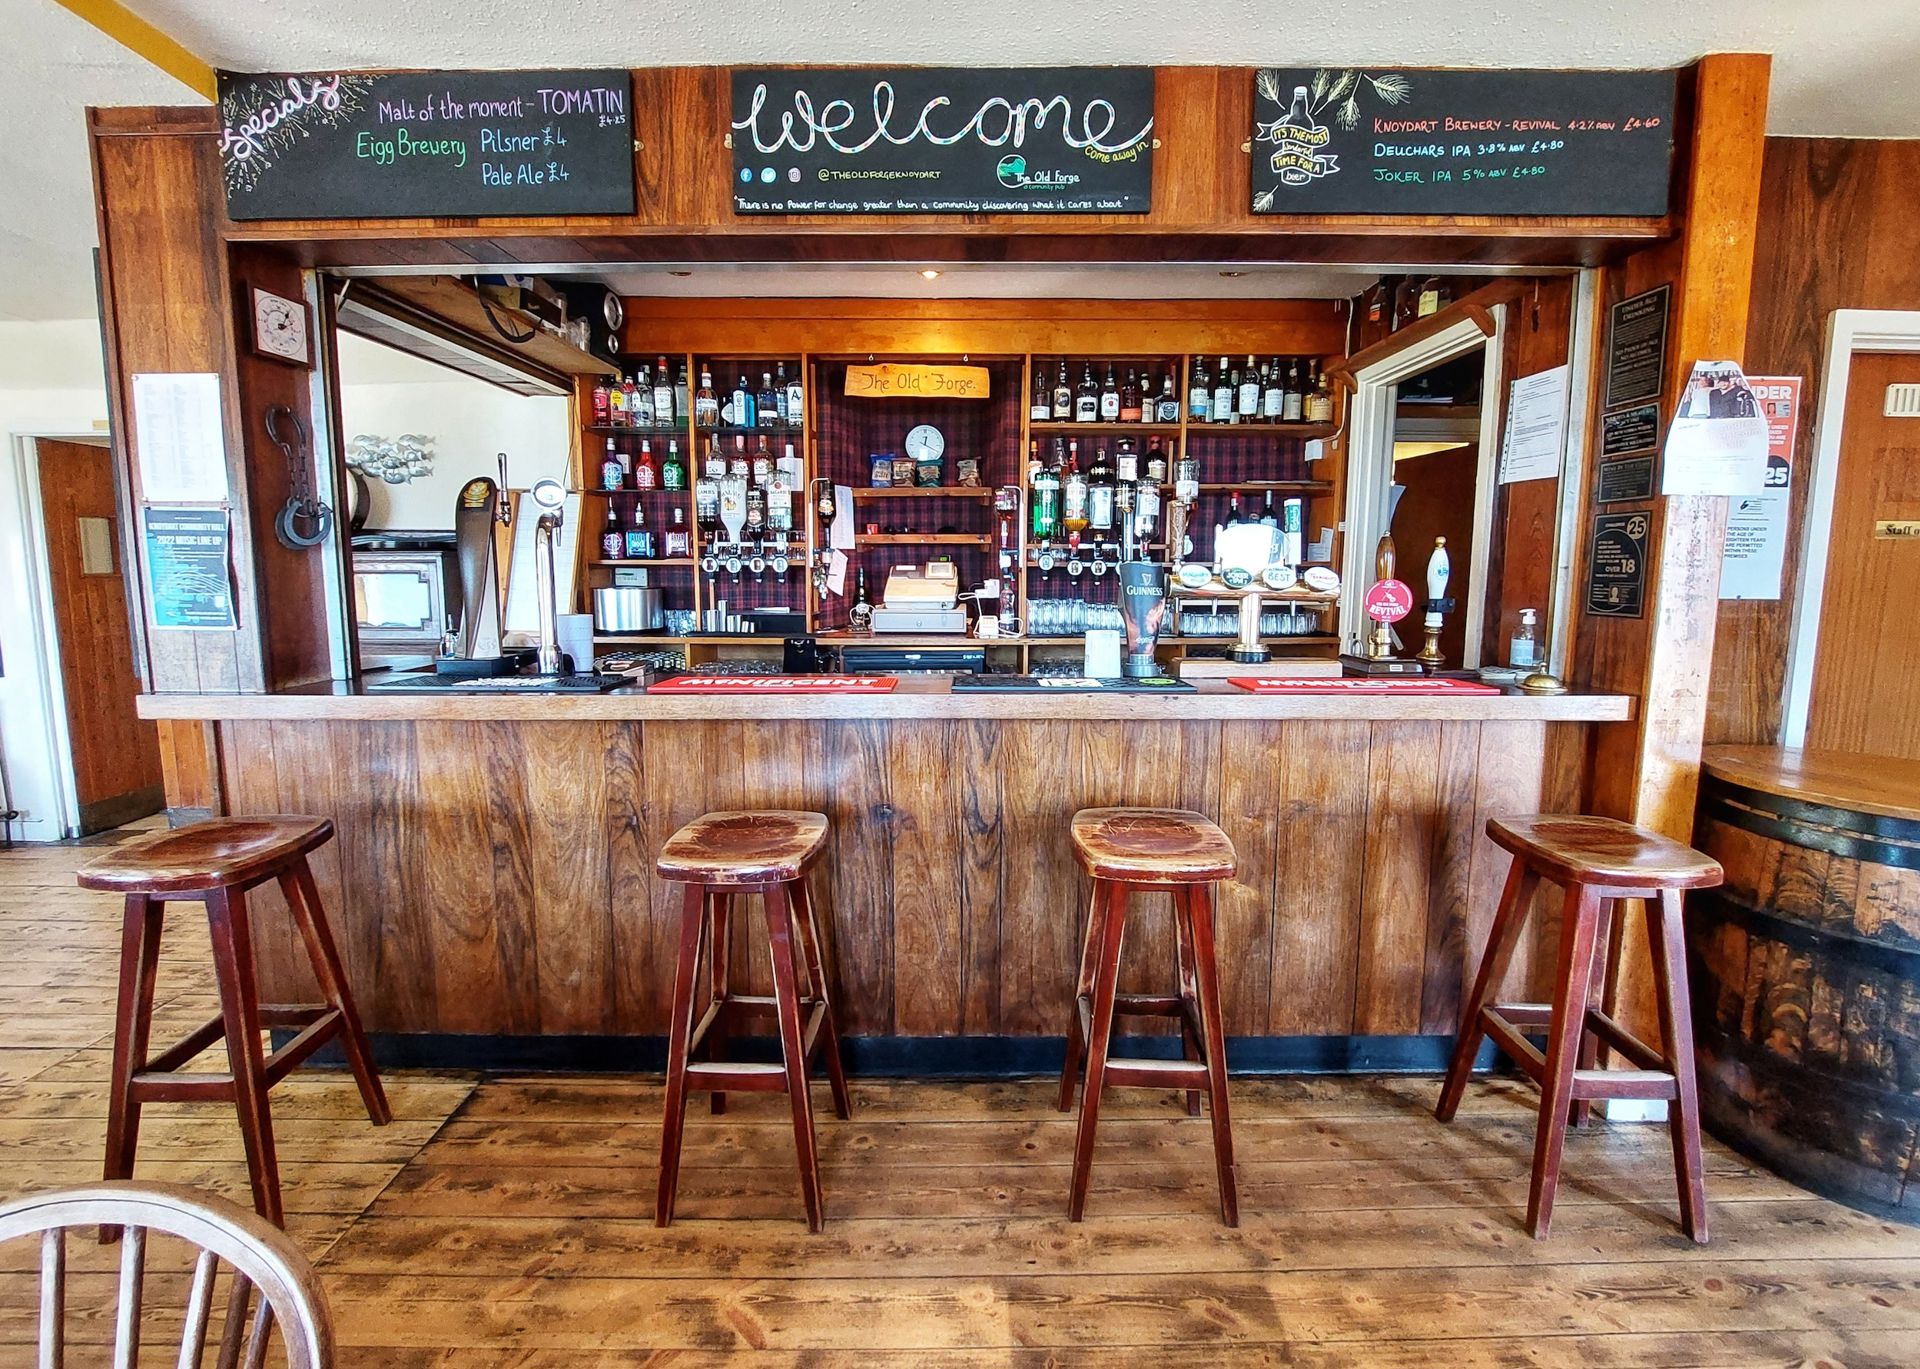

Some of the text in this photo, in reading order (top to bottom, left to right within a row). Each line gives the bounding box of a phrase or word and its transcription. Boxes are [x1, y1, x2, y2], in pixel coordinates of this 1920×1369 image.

[379, 99, 416, 124] Malt
[419, 93, 434, 121] of
[440, 91, 464, 120] the
[469, 99, 524, 119] moment
[537, 89, 623, 115] TOMATIN
[1374, 117, 1438, 133] KNOYDART
[1444, 116, 1502, 131] BREWERY
[1512, 120, 1561, 131] REVIVAL
[480, 127, 568, 152] Pilsner £4
[357, 128, 467, 168] Eigg Brewery
[1112, 148, 1138, 162] away
[1451, 145, 1471, 157] IPA
[1508, 144, 1526, 153] ABV
[1530, 140, 1565, 153] £4.80
[1297, 158, 1313, 172] FOR
[1313, 163, 1320, 173] A
[482, 162, 569, 185] Pale Ale £4
[1014, 169, 1080, 185] The Old Forge
[1285, 171, 1306, 181] beer
[1373, 166, 1546, 183] JOKER IPA 5% ABV £4.80
[761, 200, 770, 209] is
[814, 200, 826, 209] for
[828, 200, 858, 211] change
[863, 200, 892, 211] greater
[897, 199, 917, 209] than
[982, 200, 1029, 211] discovering
[1057, 200, 1065, 209] it
[1068, 201, 1092, 209] cares
[862, 373, 889, 393] The
[897, 373, 921, 392] Old
[1764, 467, 1787, 485] 25
[1628, 520, 1645, 535] 25
[1885, 523, 1913, 535] Staff
[156, 535, 222, 545] 2022 MUSIC LINE UP
[1620, 559, 1636, 573] 18
[1126, 585, 1163, 596] GUINNESS
[1368, 603, 1407, 616] REVIVAL
